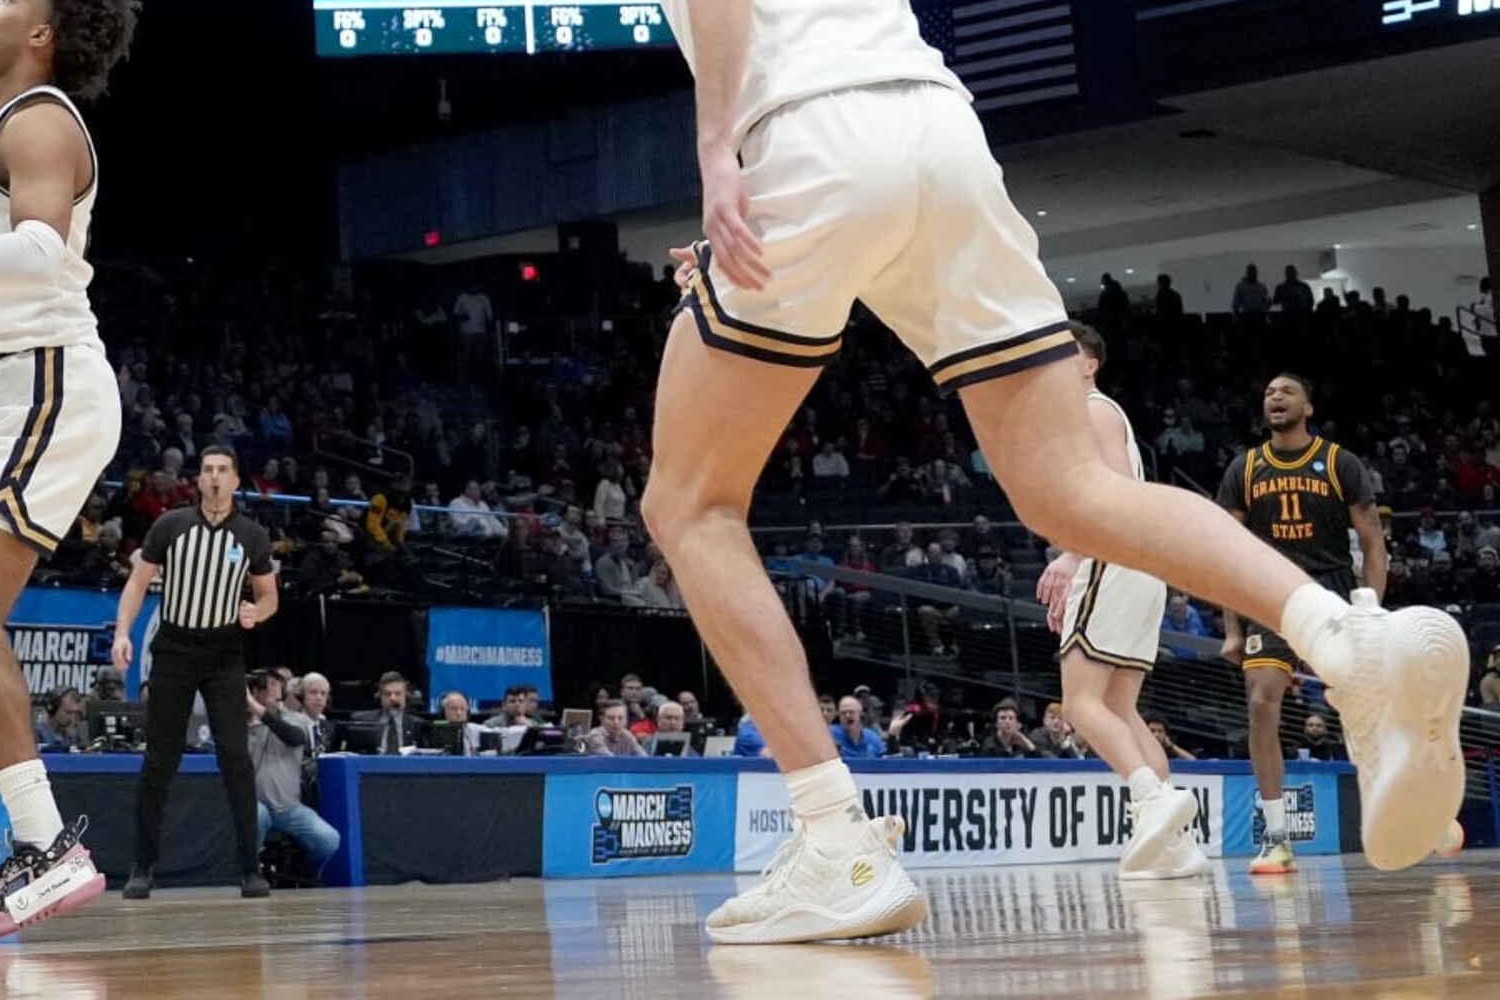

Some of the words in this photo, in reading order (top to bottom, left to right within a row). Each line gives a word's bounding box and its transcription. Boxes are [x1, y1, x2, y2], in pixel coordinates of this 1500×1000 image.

[1252, 476, 1329, 499] GRAMBLING
[1280, 493, 1302, 520] 11
[1272, 523, 1313, 539] STATE
[14, 630, 89, 662] MARCH
[23, 663, 98, 695] MADNE
[612, 794, 667, 821] MARCH
[1049, 786, 1086, 848] OF
[1097, 785, 1210, 845] DAN
[621, 821, 693, 848] MADNESS
